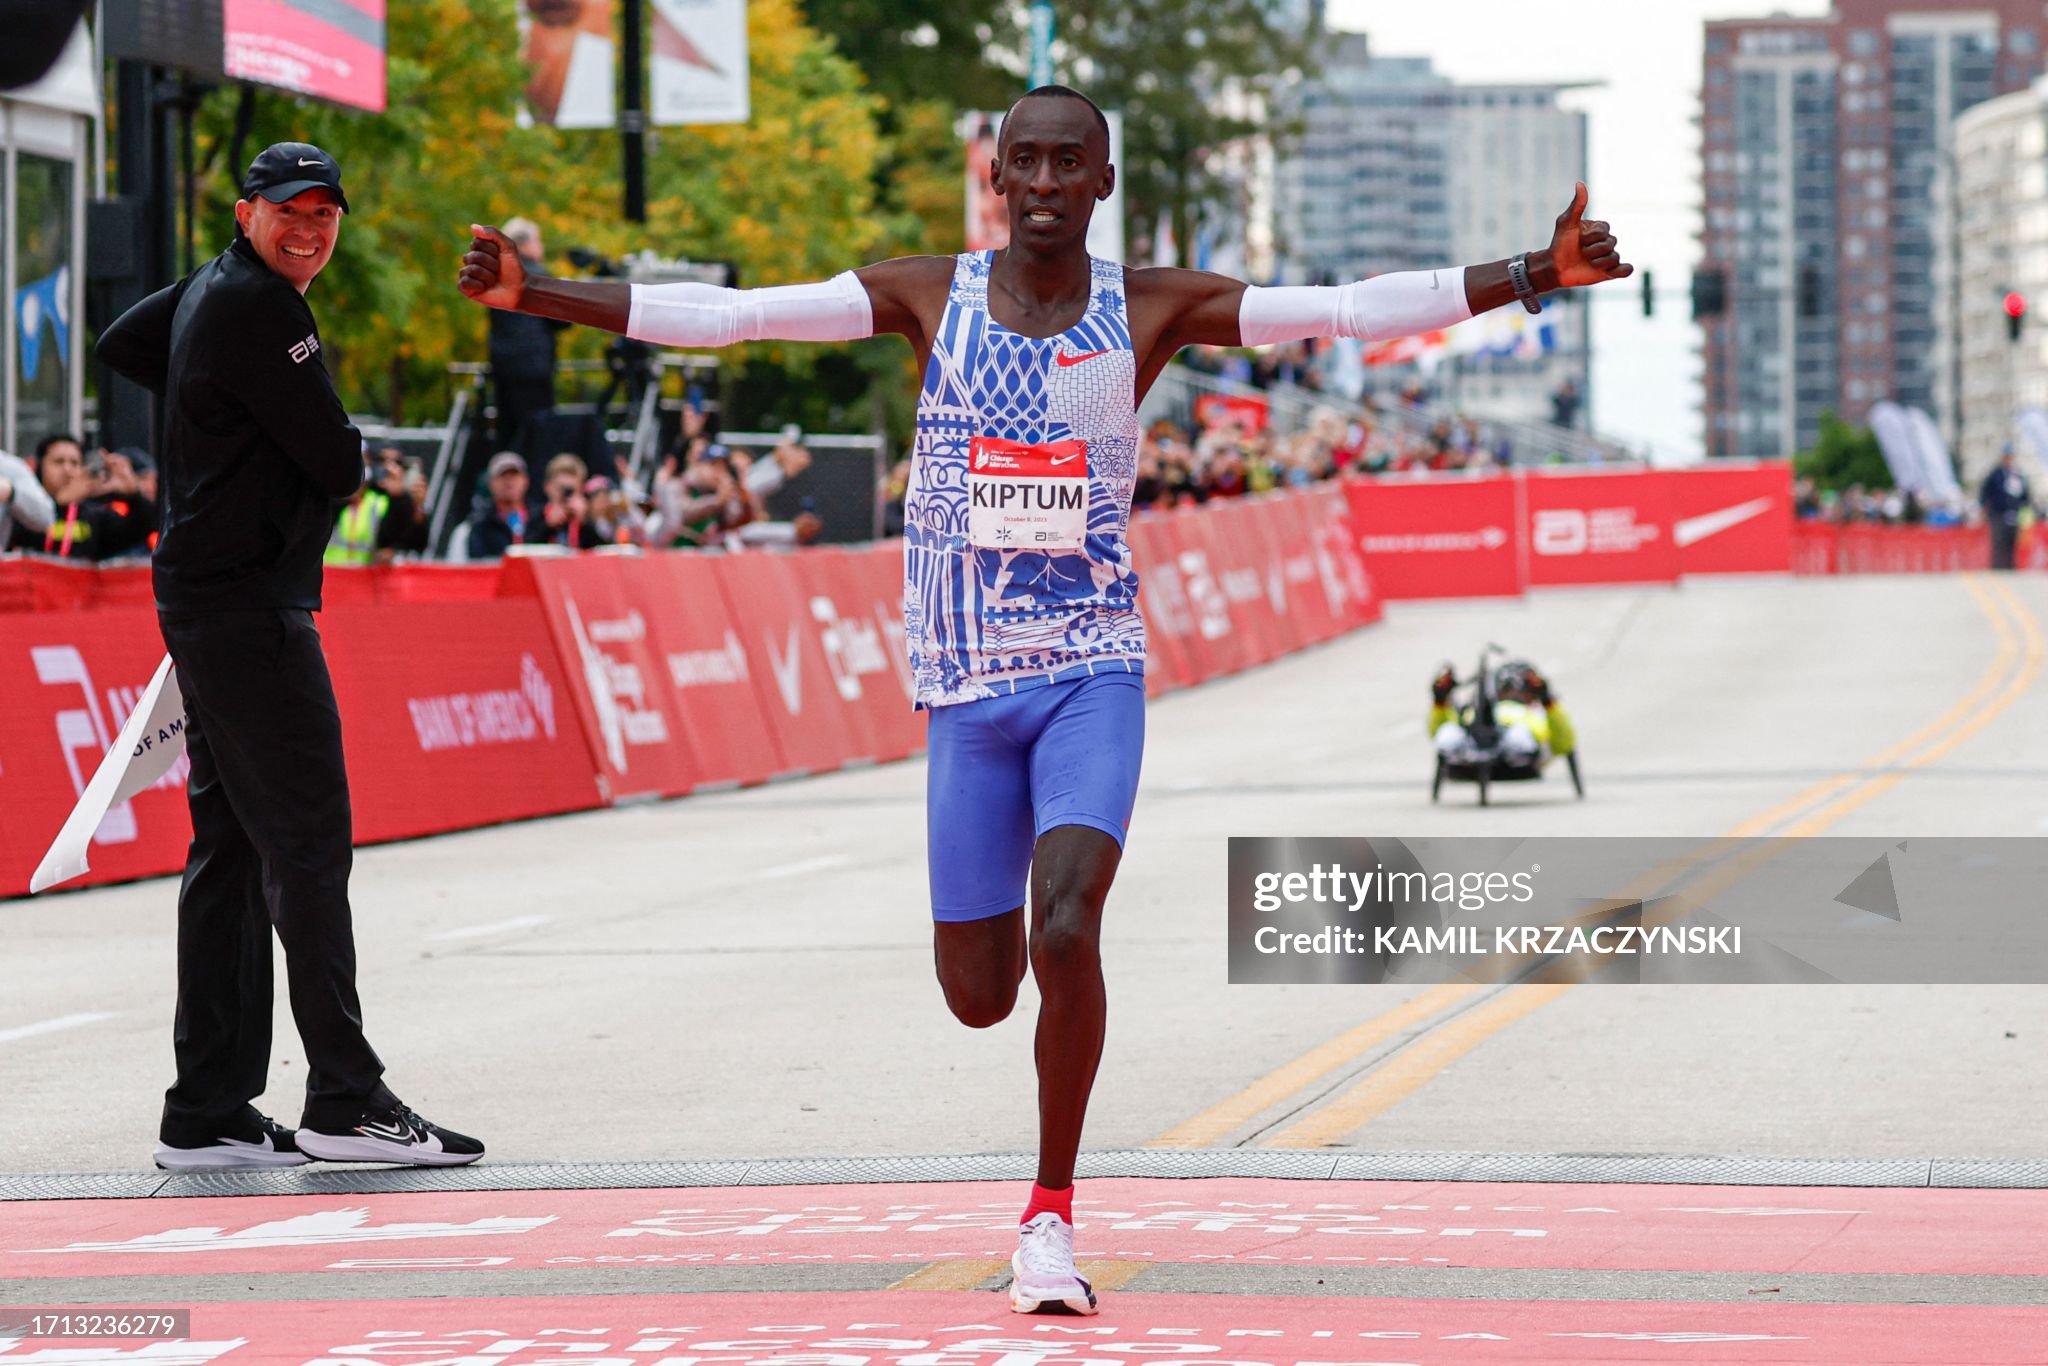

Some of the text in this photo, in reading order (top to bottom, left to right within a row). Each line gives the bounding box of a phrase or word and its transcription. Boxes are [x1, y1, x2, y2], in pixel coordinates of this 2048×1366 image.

[973, 482, 1083, 510] KIPTUM
[158, 714, 188, 744] AM
[656, 1204, 939, 1214] BANK
[1137, 1200, 1620, 1214] AMERICA
[629, 1210, 1382, 1226] Chicago
[363, 1322, 1511, 1341] BANK OF AMERICA
[327, 1336, 1223, 1356] Chicago
